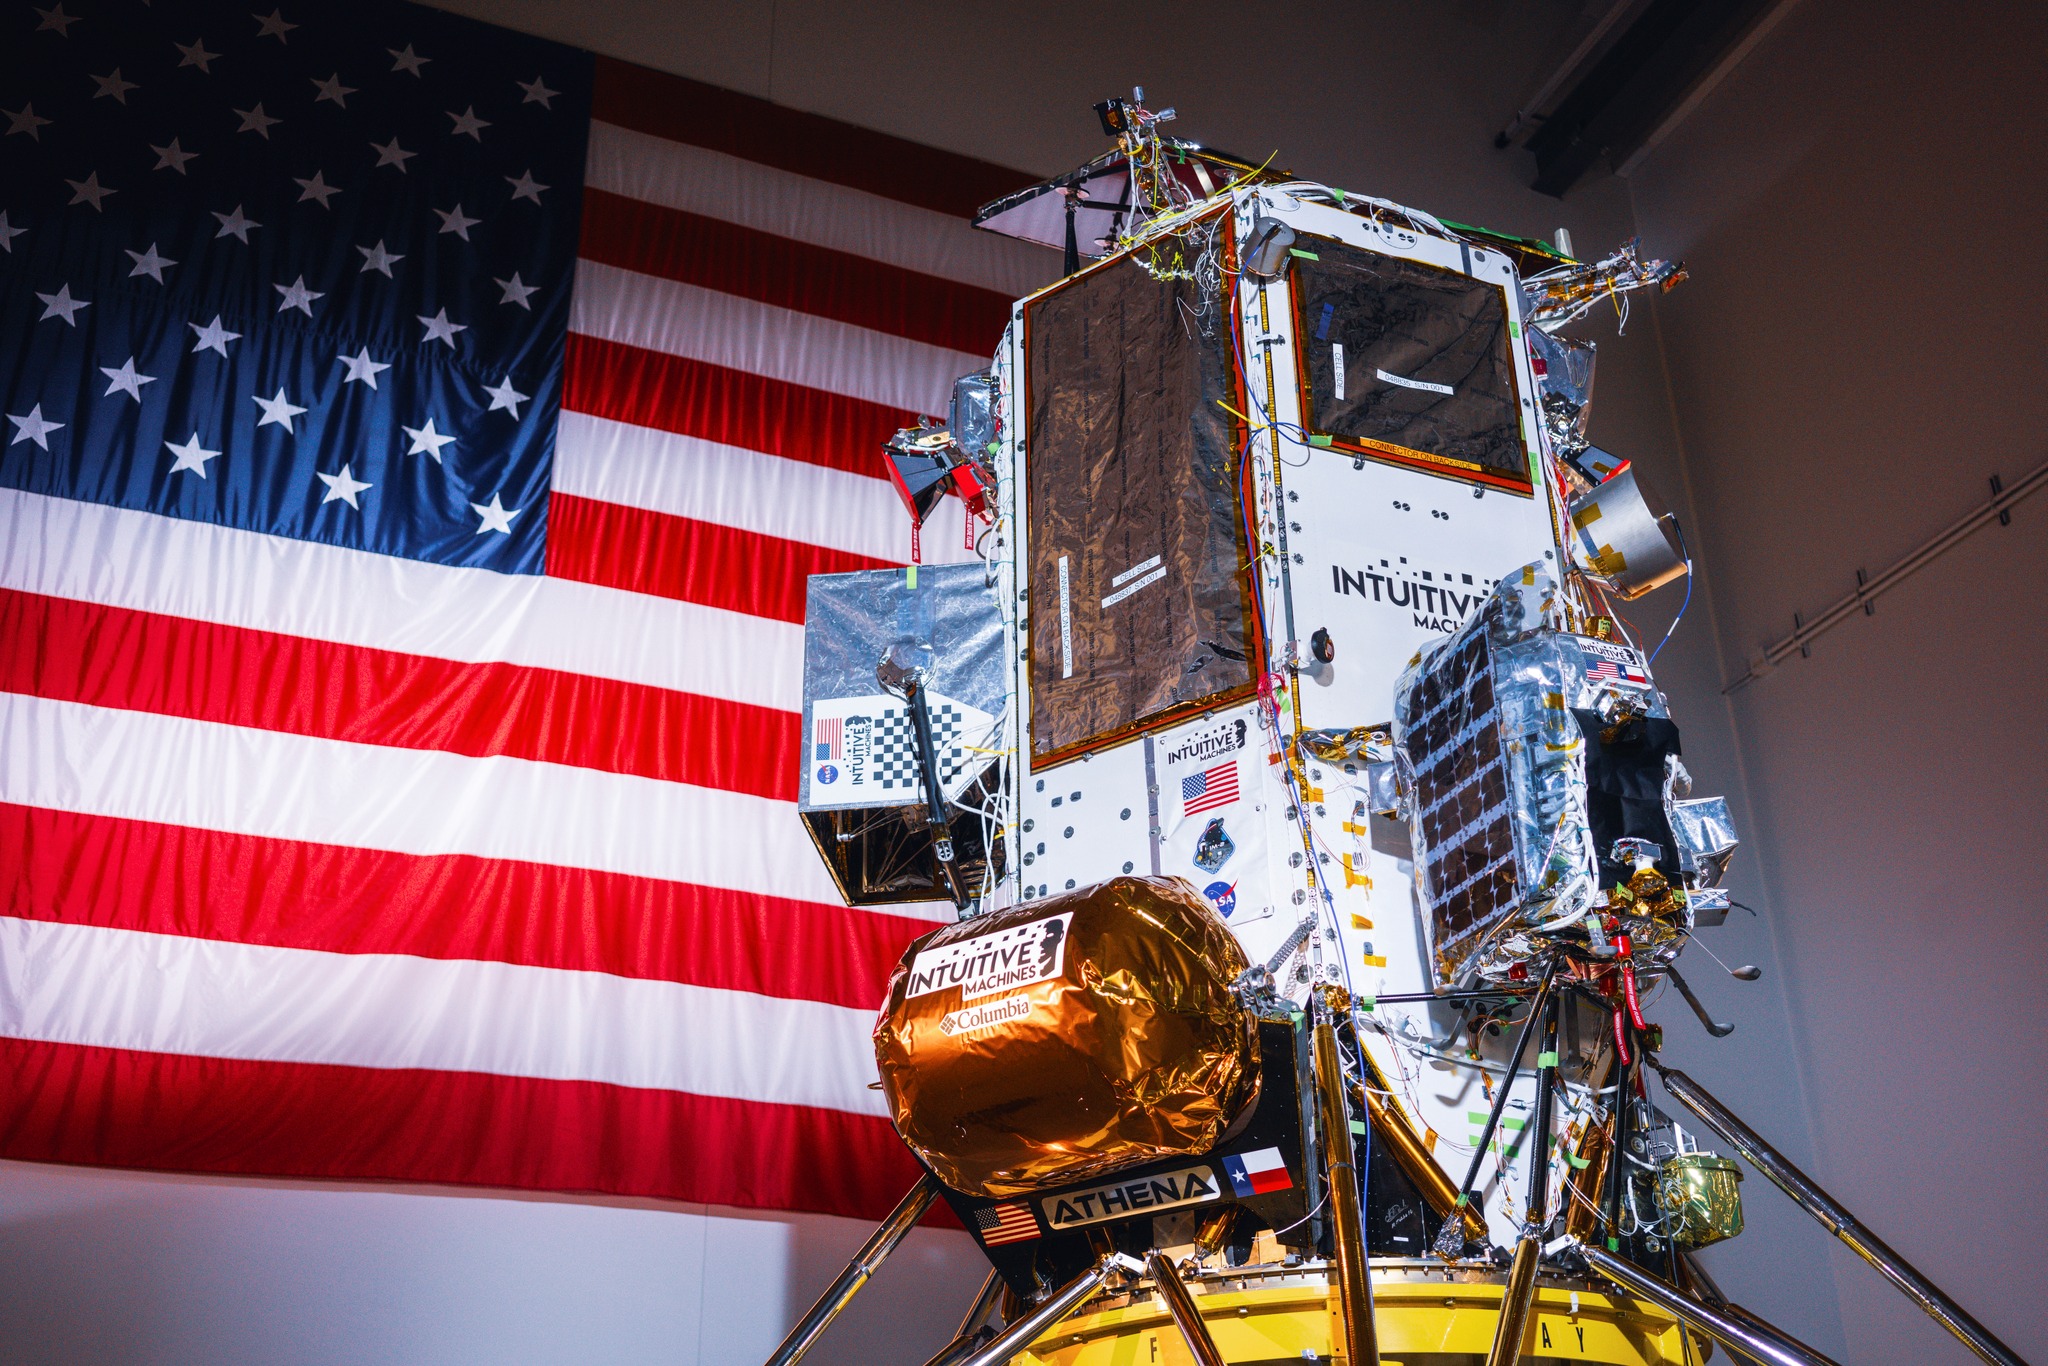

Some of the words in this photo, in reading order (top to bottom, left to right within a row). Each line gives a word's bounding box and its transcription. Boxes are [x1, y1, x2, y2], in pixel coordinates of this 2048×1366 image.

[1334, 352, 1342, 371] CELL
[1430, 384, 1444, 392] 001
[1369, 440, 1419, 458] CONNECTOR
[1420, 452, 1432, 461] ON
[1433, 455, 1472, 469] BACKSIDE
[1120, 570, 1136, 582] CELL
[1137, 559, 1153, 573] SIDE
[1146, 572, 1158, 582] 001
[1060, 565, 1069, 614] CONNECTOR
[1063, 615, 1069, 628] ON
[1063, 629, 1071, 669] BACKSIDE
[1579, 643, 1627, 660] INTUITIVE
[852, 727, 864, 785] INTUITIVE
[1168, 732, 1233, 765] INTUITIVE
[1199, 743, 1236, 762] MACHINES
[1211, 894, 1235, 907] ASA
[908, 940, 1034, 996] INTUITIVE
[965, 965, 1036, 996] MACHINES
[957, 999, 1030, 1029] Columbia
[1054, 1172, 1217, 1225] ATHENA
